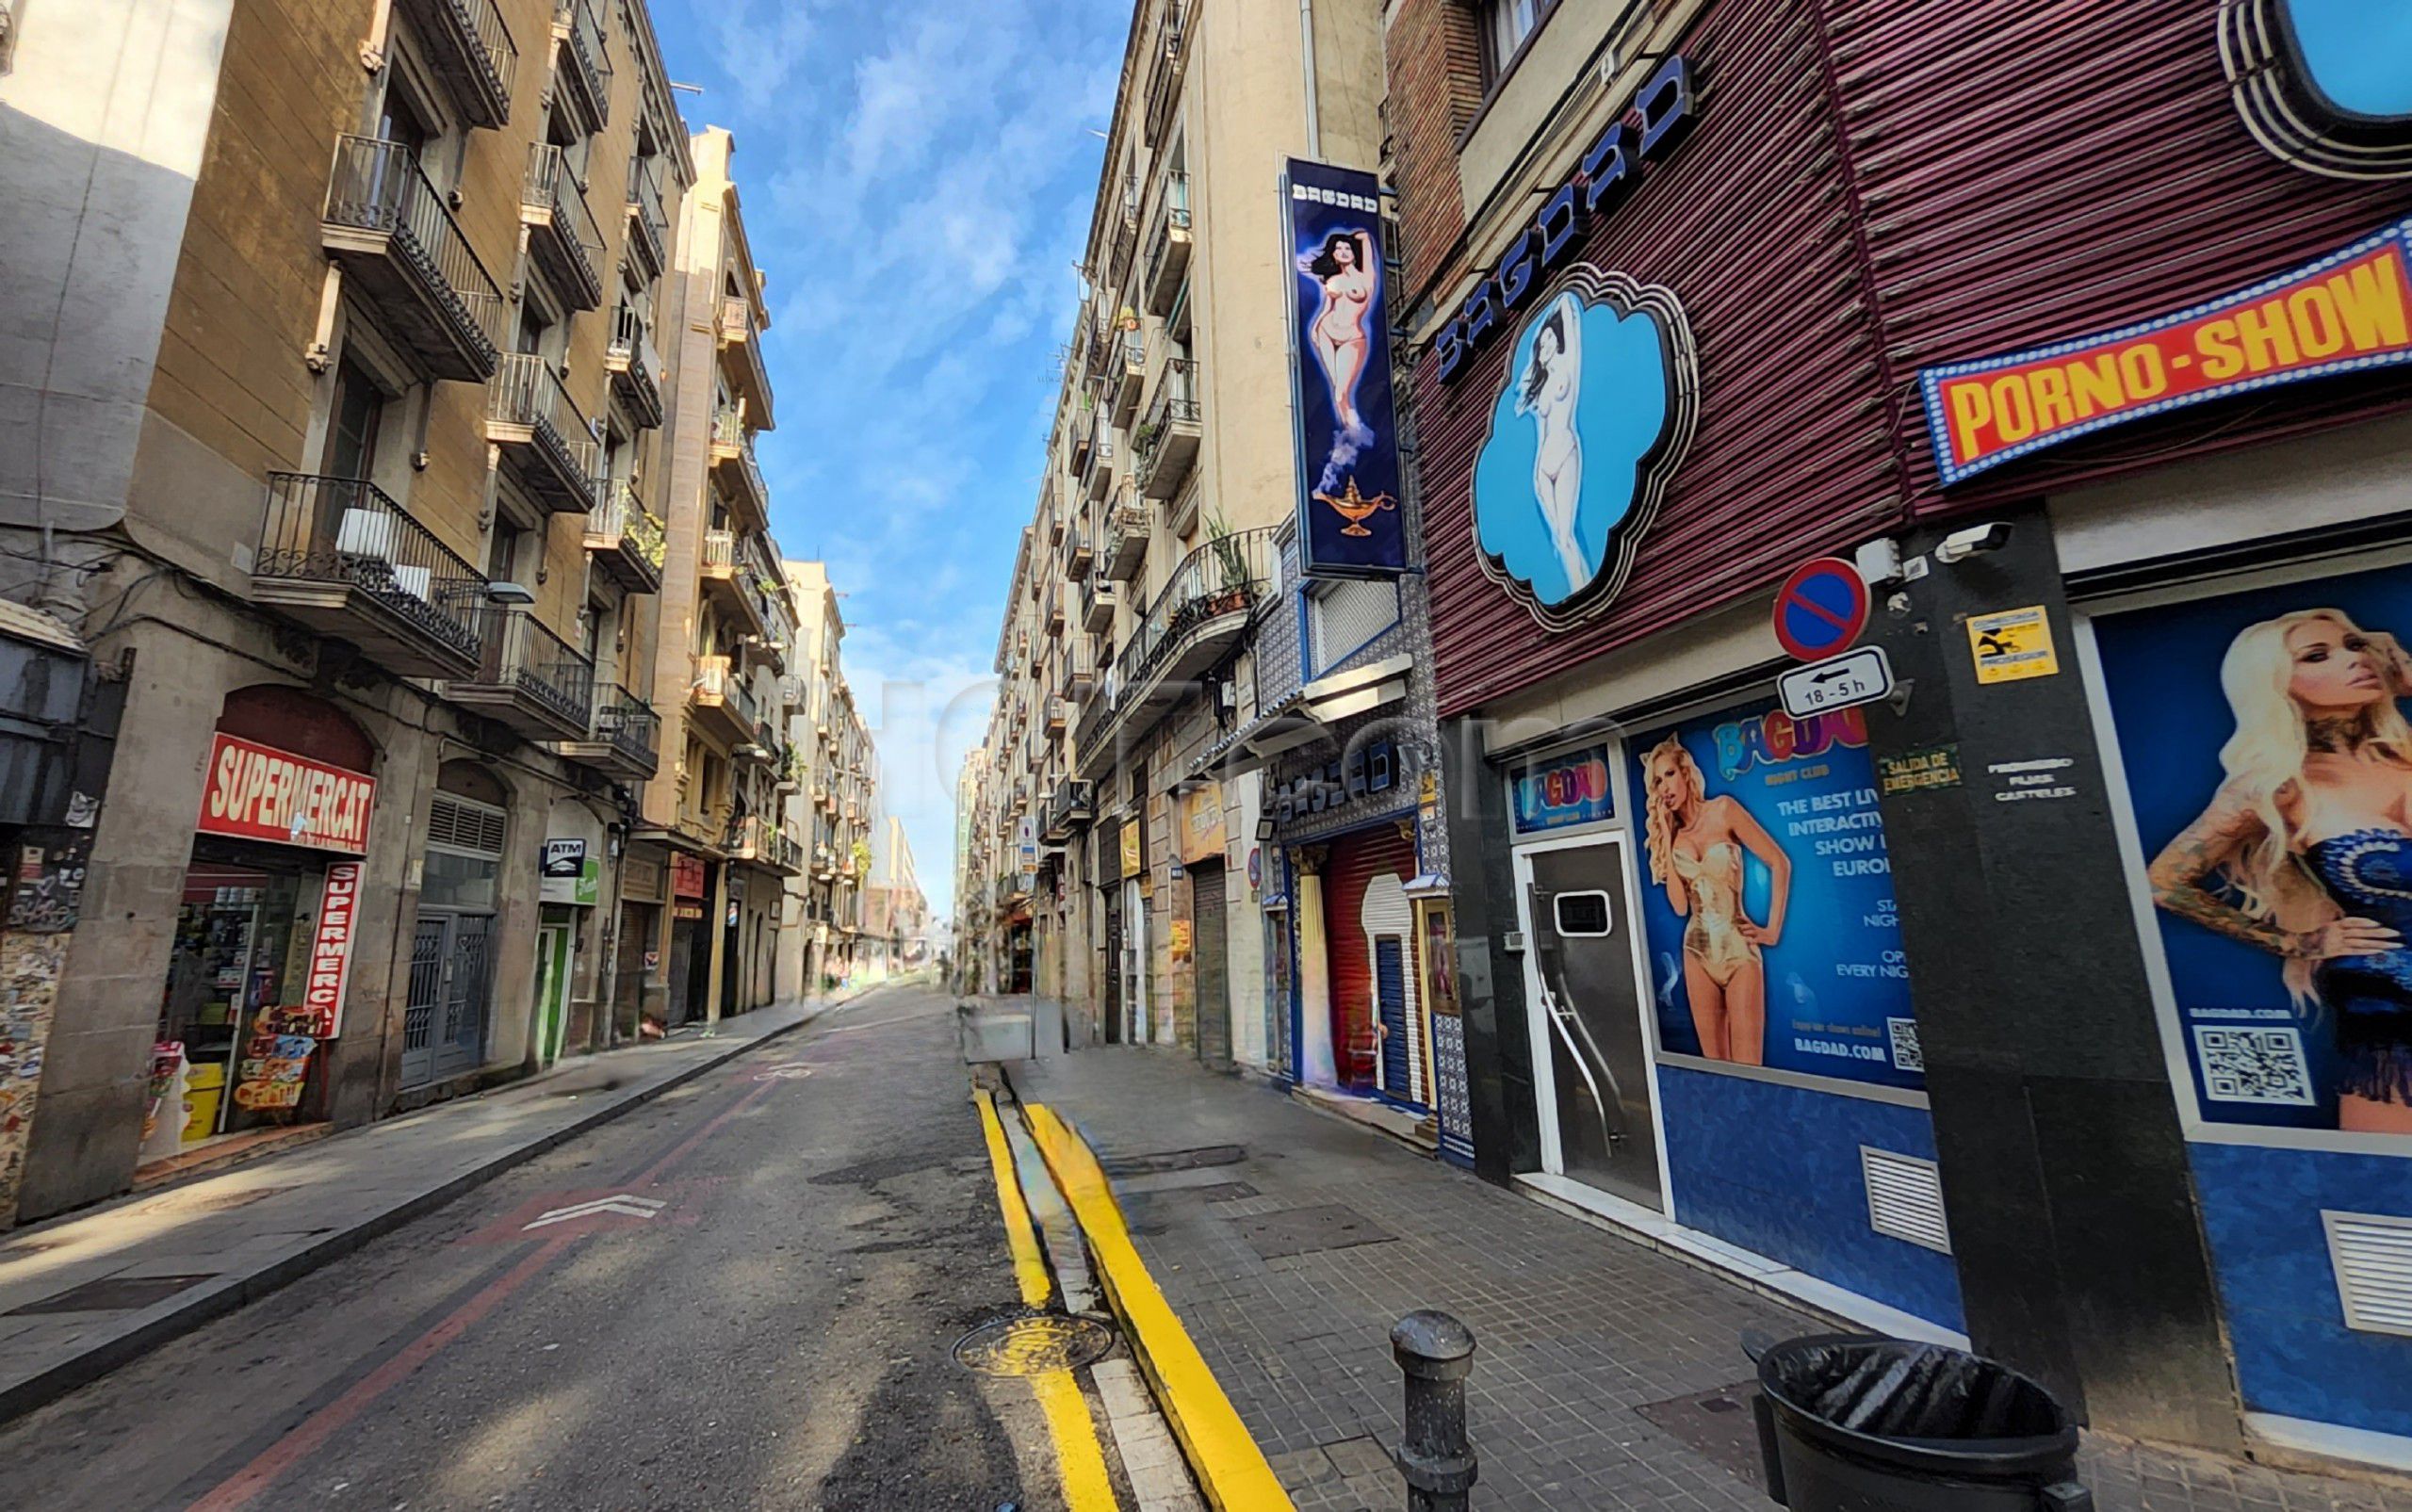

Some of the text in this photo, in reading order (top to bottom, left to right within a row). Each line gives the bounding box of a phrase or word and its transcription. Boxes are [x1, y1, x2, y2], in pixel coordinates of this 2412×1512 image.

[1292, 184, 1378, 213] BAGDAD
[1435, 53, 1696, 384] BAGDAD
[1805, 690, 1824, 706] 18
[1852, 679, 1866, 693] h
[1888, 753, 1948, 775] SALIDA DE
[1884, 768, 1960, 790] EMERGENCIA
[210, 744, 371, 841] SUPERMERCAT
[1777, 800, 1808, 817] THE
[1811, 792, 1852, 812] BEST
[550, 843, 582, 854] ATM
[1815, 835, 1875, 855] SHOW
[309, 867, 356, 1034] SUPERMERC
[1882, 950, 1906, 963] OP
[1836, 964, 1877, 977] EVERY
[1794, 1037, 1887, 1063] BAGDAD.COM
